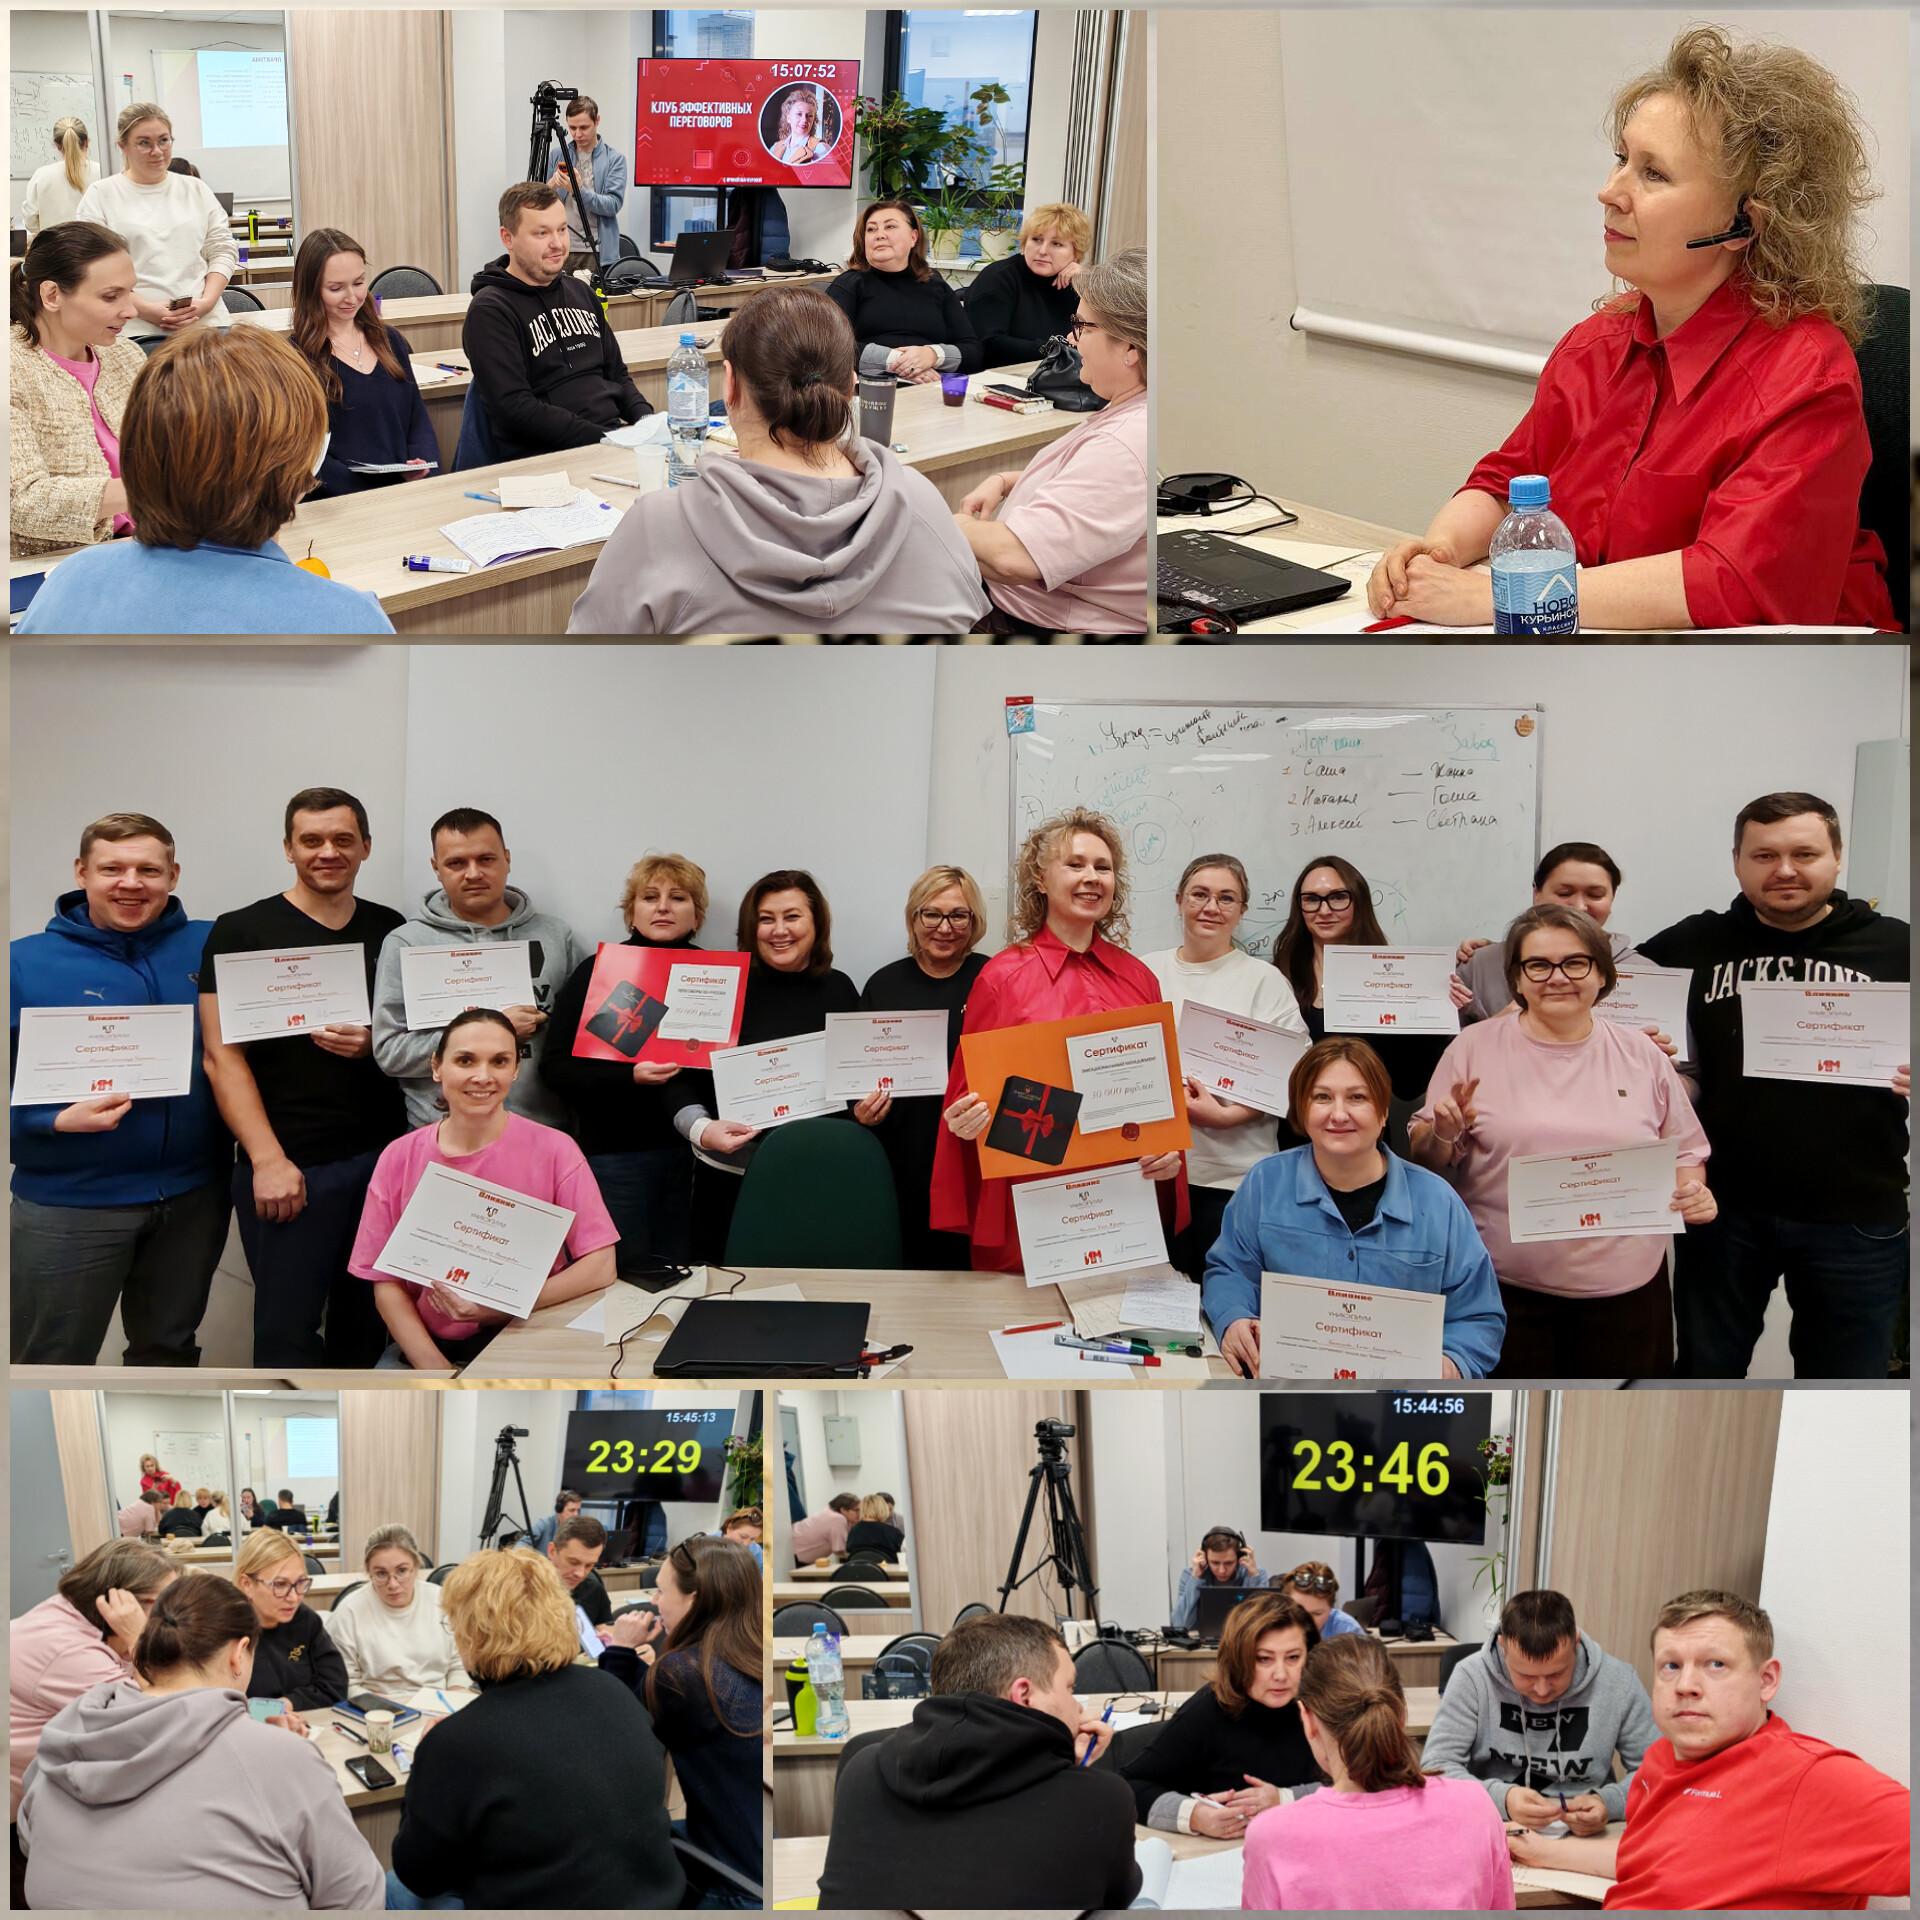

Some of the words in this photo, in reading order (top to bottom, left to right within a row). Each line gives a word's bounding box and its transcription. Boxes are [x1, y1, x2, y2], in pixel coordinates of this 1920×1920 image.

[771, 64, 836, 78] 15:07:52
[651, 101, 677, 114] КЛУБ
[679, 102, 752, 115] ЭФФЕКТИВНЫХ
[669, 115, 733, 128] ПЕРЕГОВОРОВ
[1533, 594, 1577, 614] НОВО
[1304, 759, 1345, 776] Саша
[1432, 785, 1481, 806] Гоша
[267, 981, 322, 992] Сертификат
[444, 975, 493, 985] Сертификат
[680, 975, 727, 984] Сертификат
[1363, 981, 1413, 989] Сертификат
[1796, 1020, 1865, 1032] Сертификат
[75, 1044, 140, 1053] Сертификат
[864, 1044, 910, 1053] Сертификат
[1084, 1040, 1148, 1058] Сертификат
[1213, 1041, 1260, 1060] Сертификат
[754, 1072, 800, 1085] Сертификат
[1559, 1177, 1621, 1189] Сертификат
[1061, 1209, 1114, 1225] Сертификат
[453, 1220, 510, 1246] Сертификат
[1315, 1321, 1383, 1339] Сертификат
[1393, 1398, 1465, 1414] 15:44:56
[665, 1411, 717, 1424] 15:45:13
[585, 1439, 702, 1474] 23:29
[1292, 1439, 1450, 1496] 23:46
